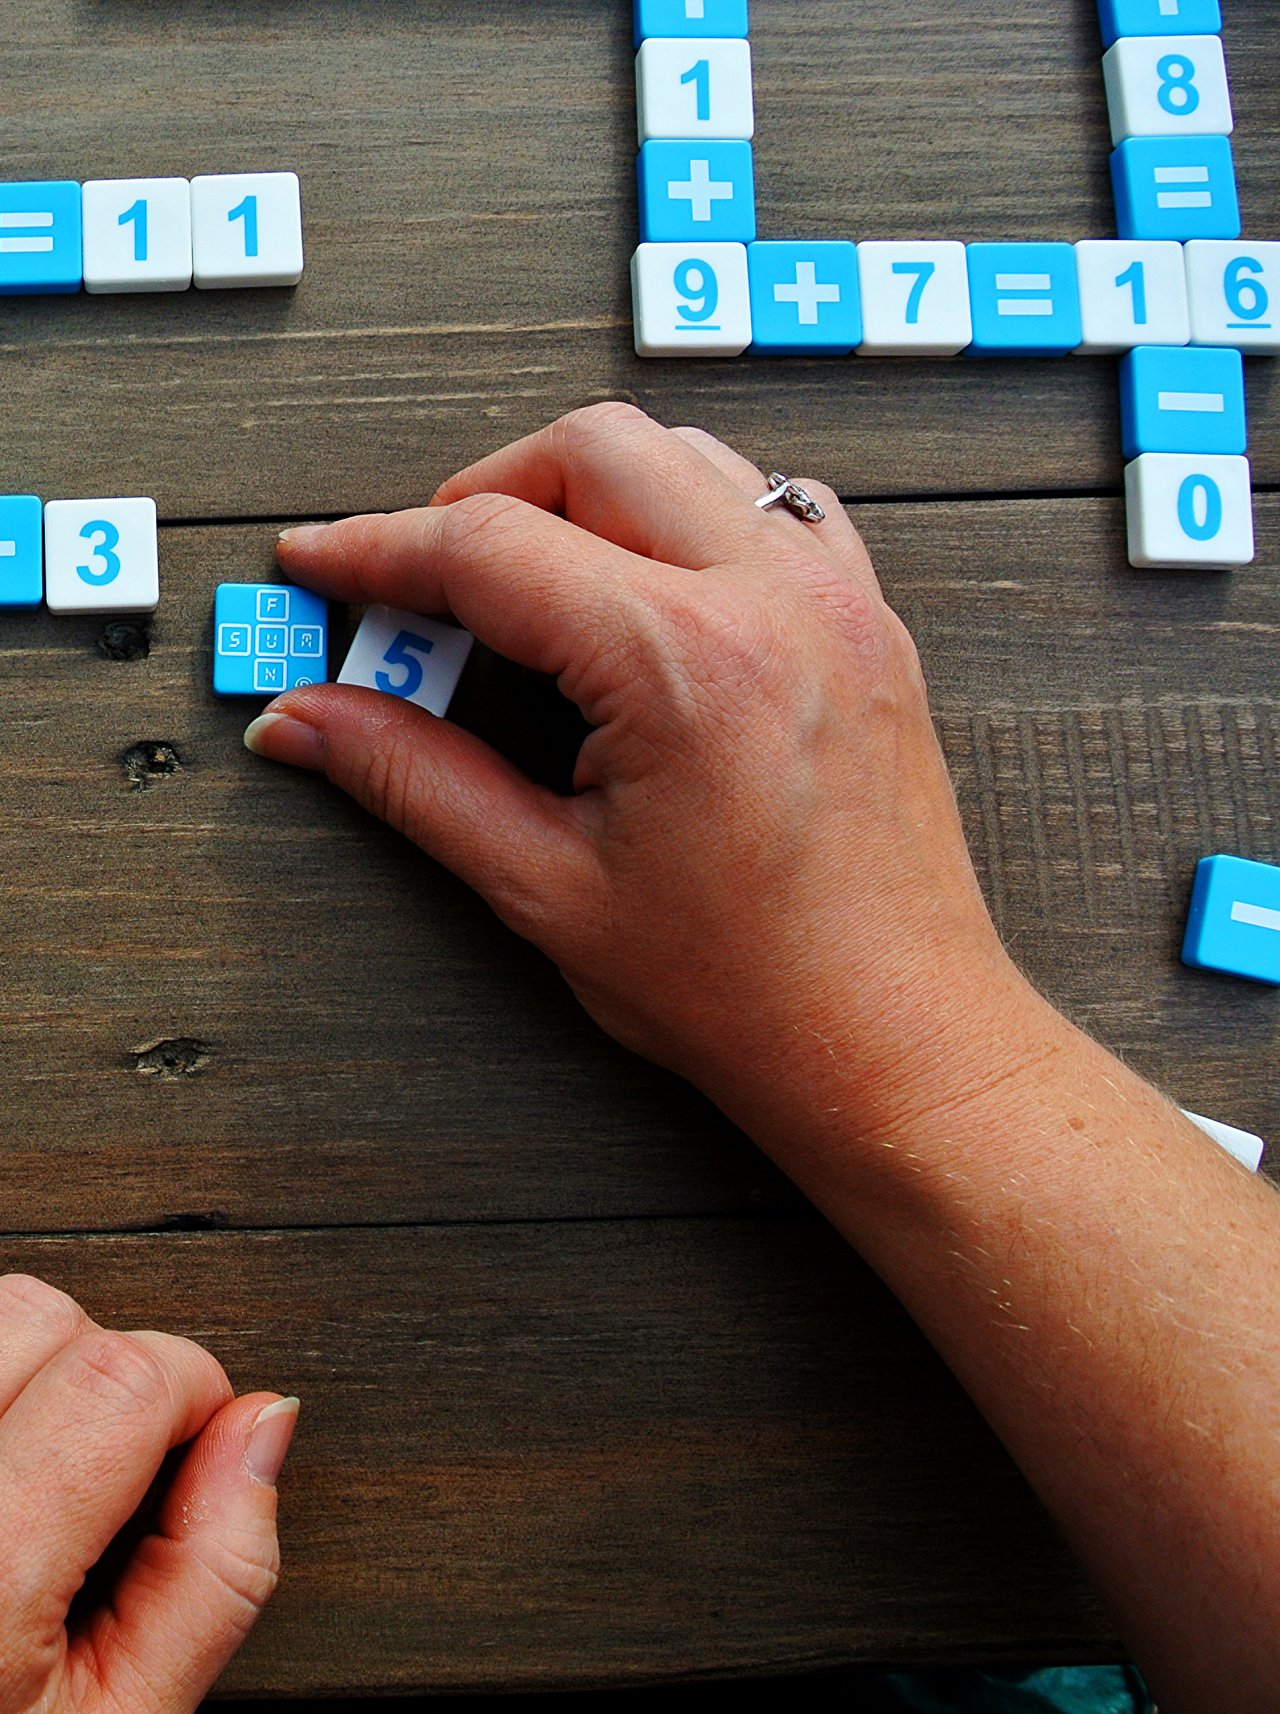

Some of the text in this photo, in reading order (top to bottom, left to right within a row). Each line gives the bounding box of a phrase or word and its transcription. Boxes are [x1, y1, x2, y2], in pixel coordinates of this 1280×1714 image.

[679, 59, 711, 121] 1
[1155, 53, 1201, 117] 8
[117, 199, 148, 262] 1
[227, 195, 258, 257] 1
[673, 258, 721, 331] 9
[891, 261, 936, 325] 7
[1113, 260, 1148, 325] 1
[1222, 255, 1273, 330] 6
[76, 519, 121, 587] 3
[374, 629, 435, 699] 5
